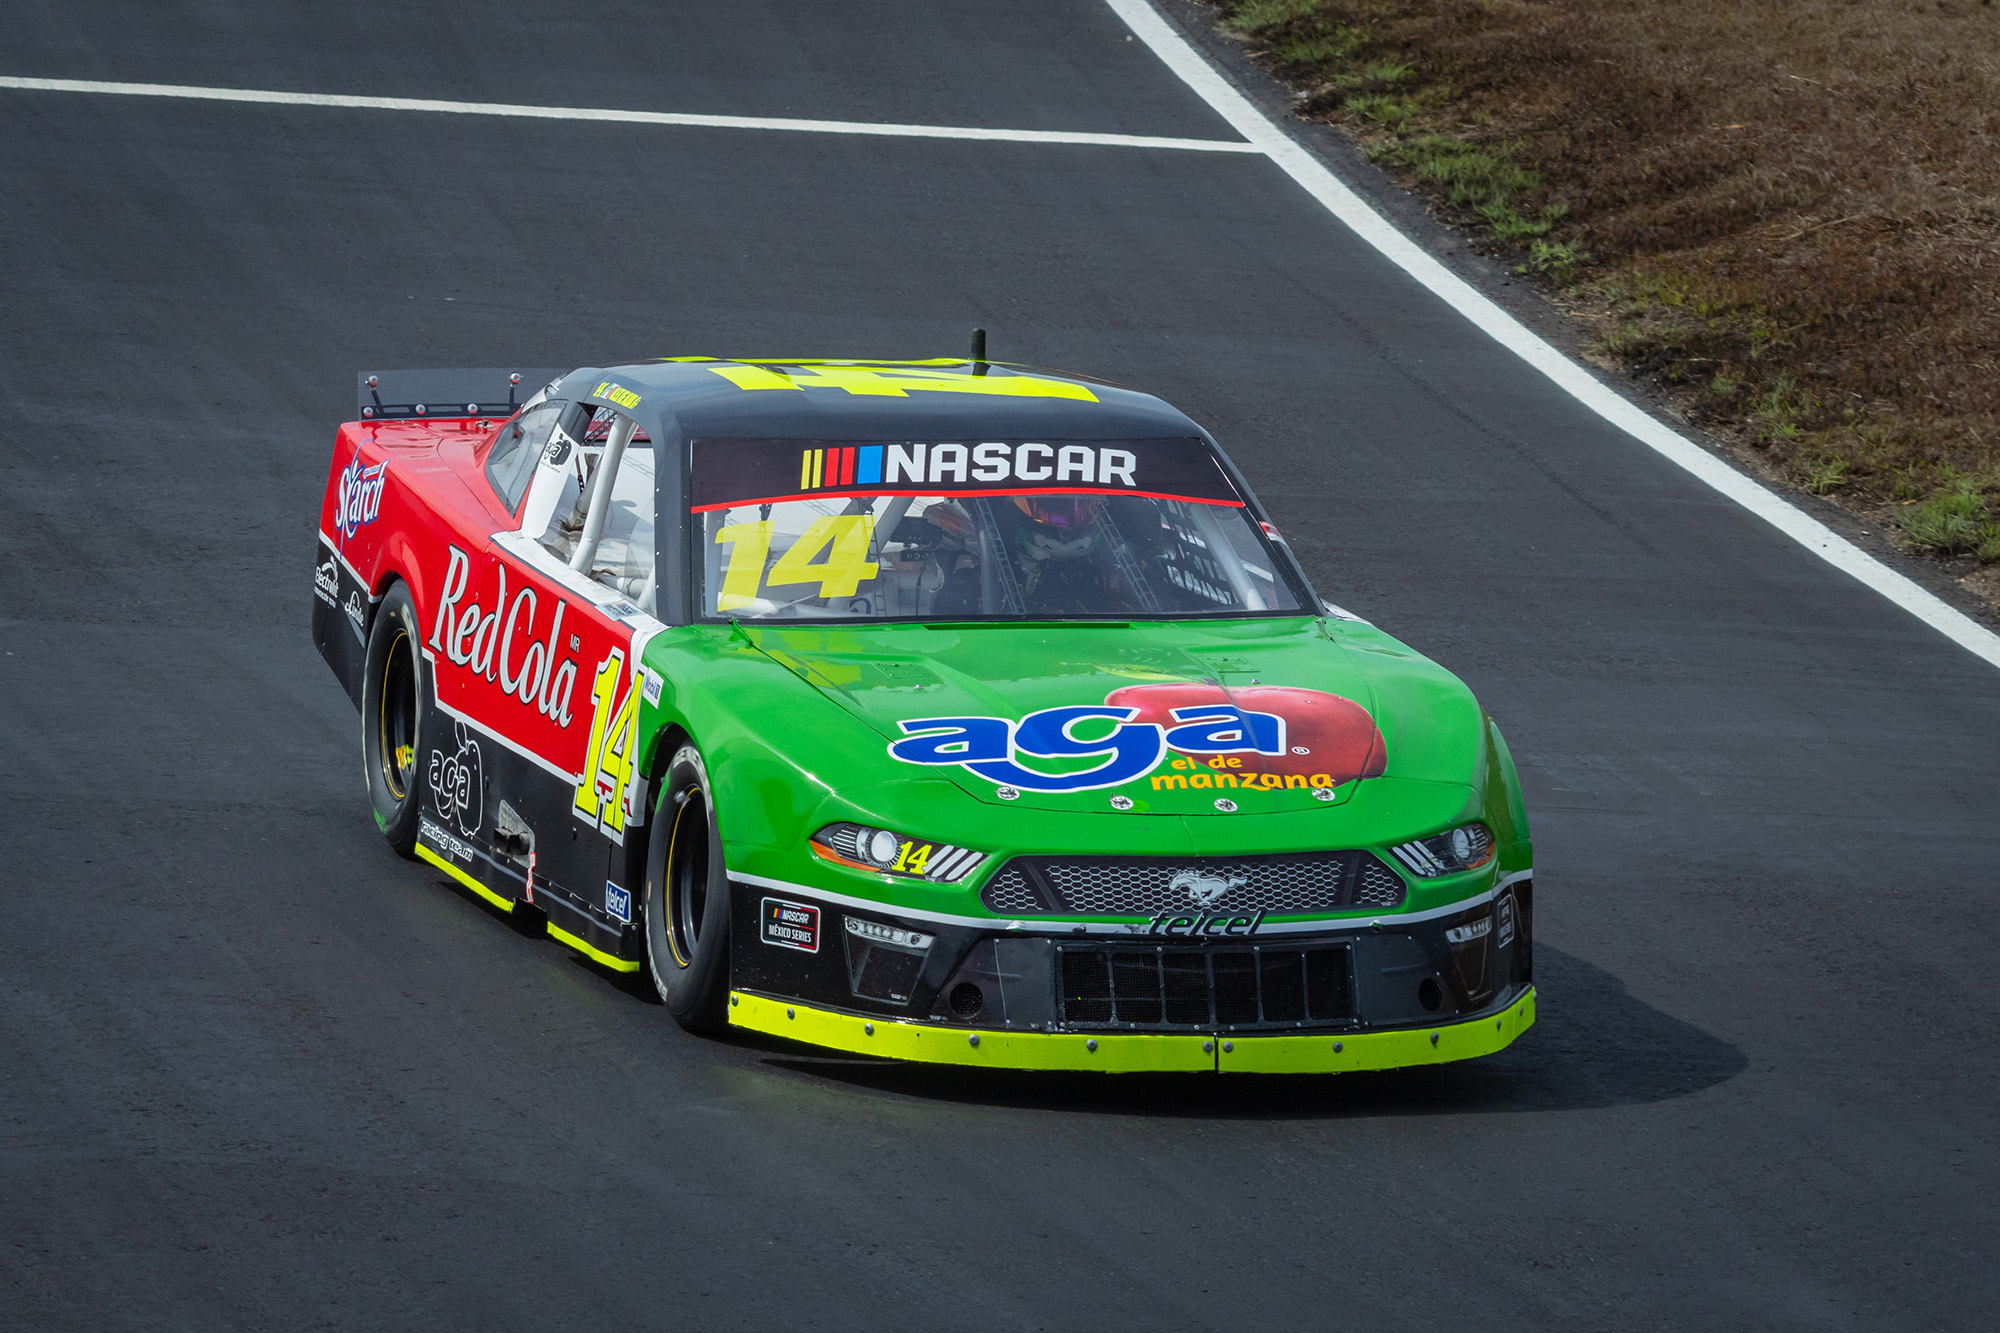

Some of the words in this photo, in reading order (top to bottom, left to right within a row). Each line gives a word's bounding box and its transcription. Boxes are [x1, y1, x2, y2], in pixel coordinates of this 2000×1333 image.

[886, 444, 1136, 487] NASCAR
[334, 457, 391, 541] Starch
[714, 514, 878, 612] 14
[573, 648, 646, 842] 14
[887, 704, 1286, 793] aga
[1171, 757, 1195, 771] el
[1208, 754, 1242, 770] de
[1151, 771, 1333, 792] manzana
[420, 821, 450, 850] racing
[448, 837, 474, 862] team
[889, 840, 931, 874] 14
[608, 887, 627, 915] telcel
[782, 909, 809, 924] NASCAR
[769, 923, 791, 938] MÉXICO
[791, 929, 812, 943] SERIES
[1149, 908, 1265, 936] telcel
